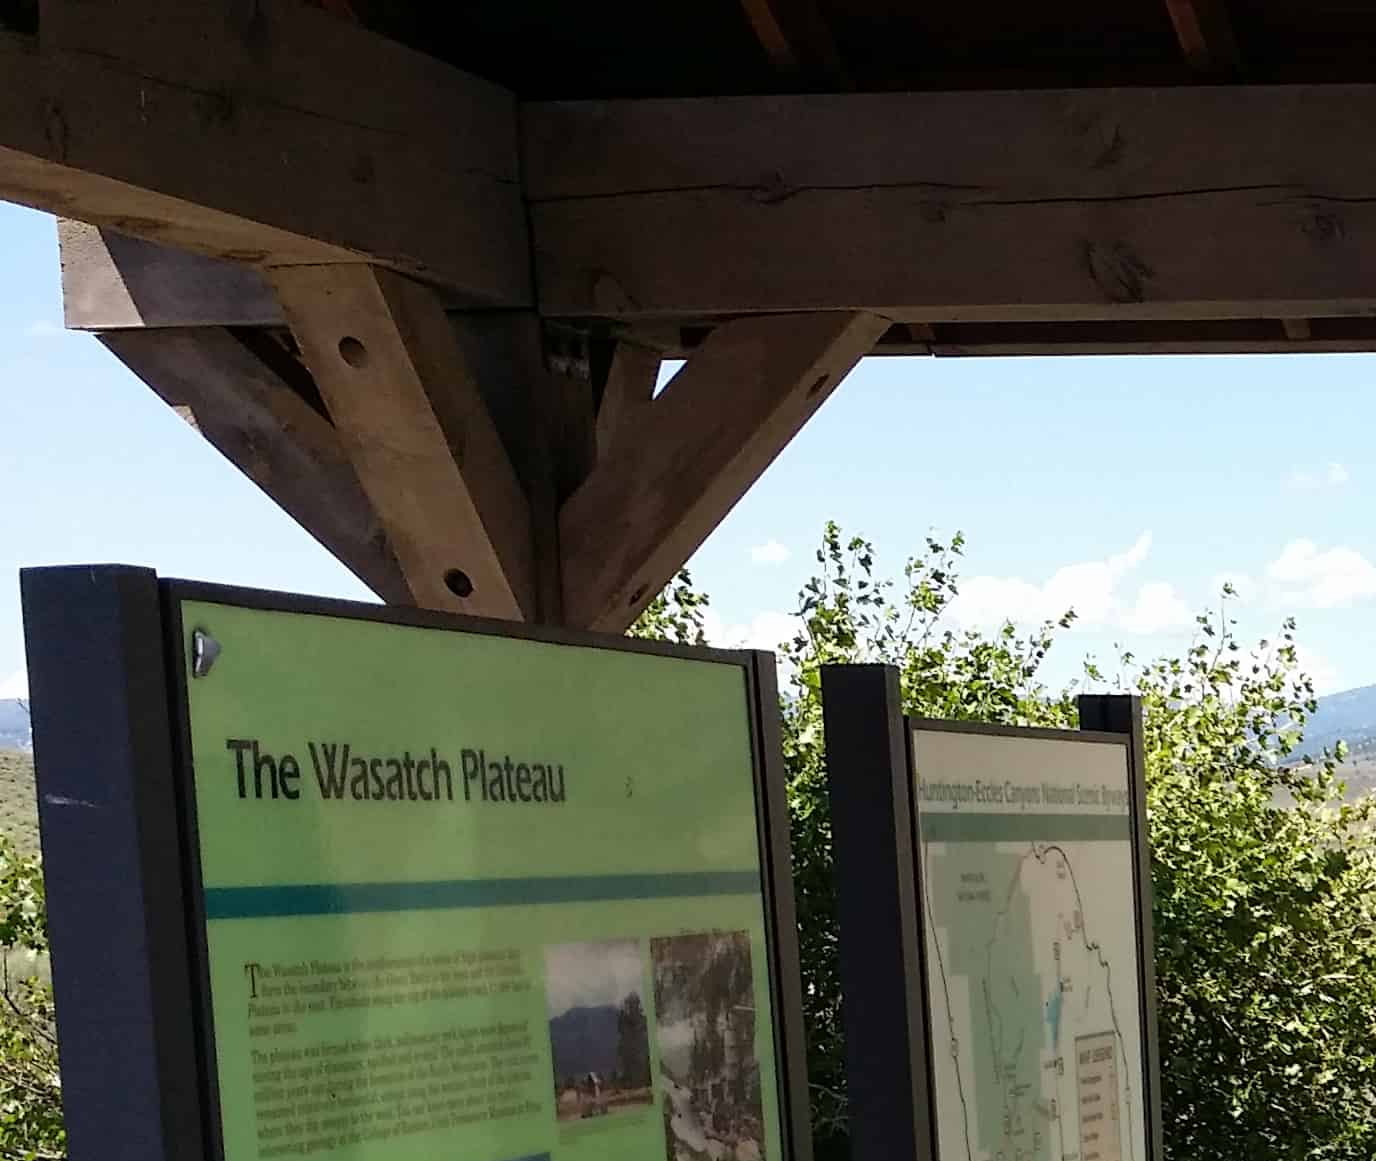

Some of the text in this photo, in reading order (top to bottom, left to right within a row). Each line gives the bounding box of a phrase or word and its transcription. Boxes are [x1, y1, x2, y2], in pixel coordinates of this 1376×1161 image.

[226, 738, 566, 804] The Wasatch Plateau
